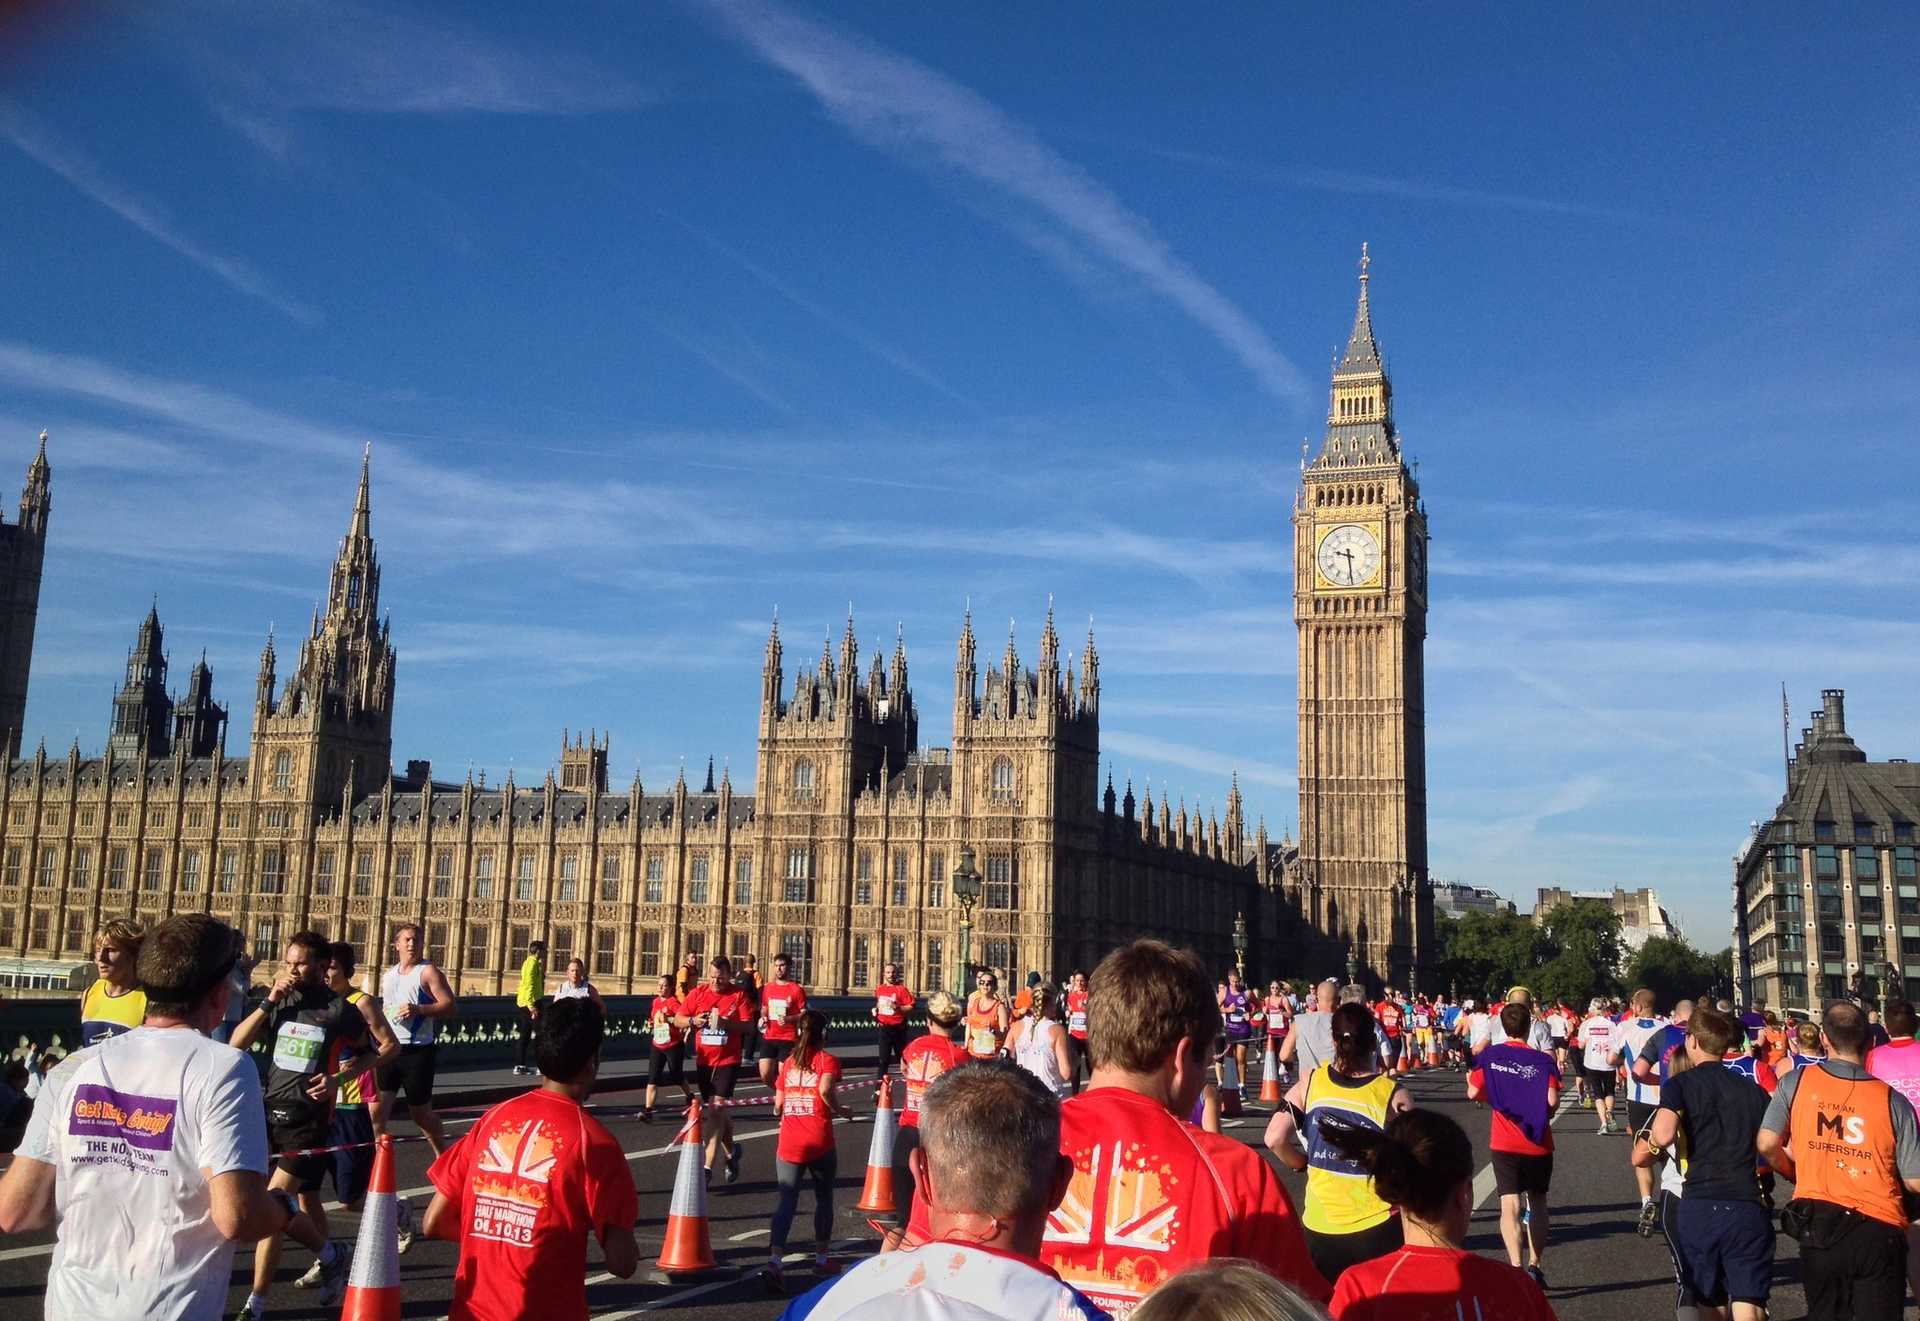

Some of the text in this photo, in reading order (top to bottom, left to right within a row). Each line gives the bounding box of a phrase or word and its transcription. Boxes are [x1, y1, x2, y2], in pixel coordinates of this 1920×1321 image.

[75, 1099, 102, 1118] Get
[1817, 1111, 1865, 1145] MS
[86, 1140, 108, 1152] THE
[132, 1149, 156, 1163] TEAM
[1808, 1140, 1872, 1161] SUPERSTAR
